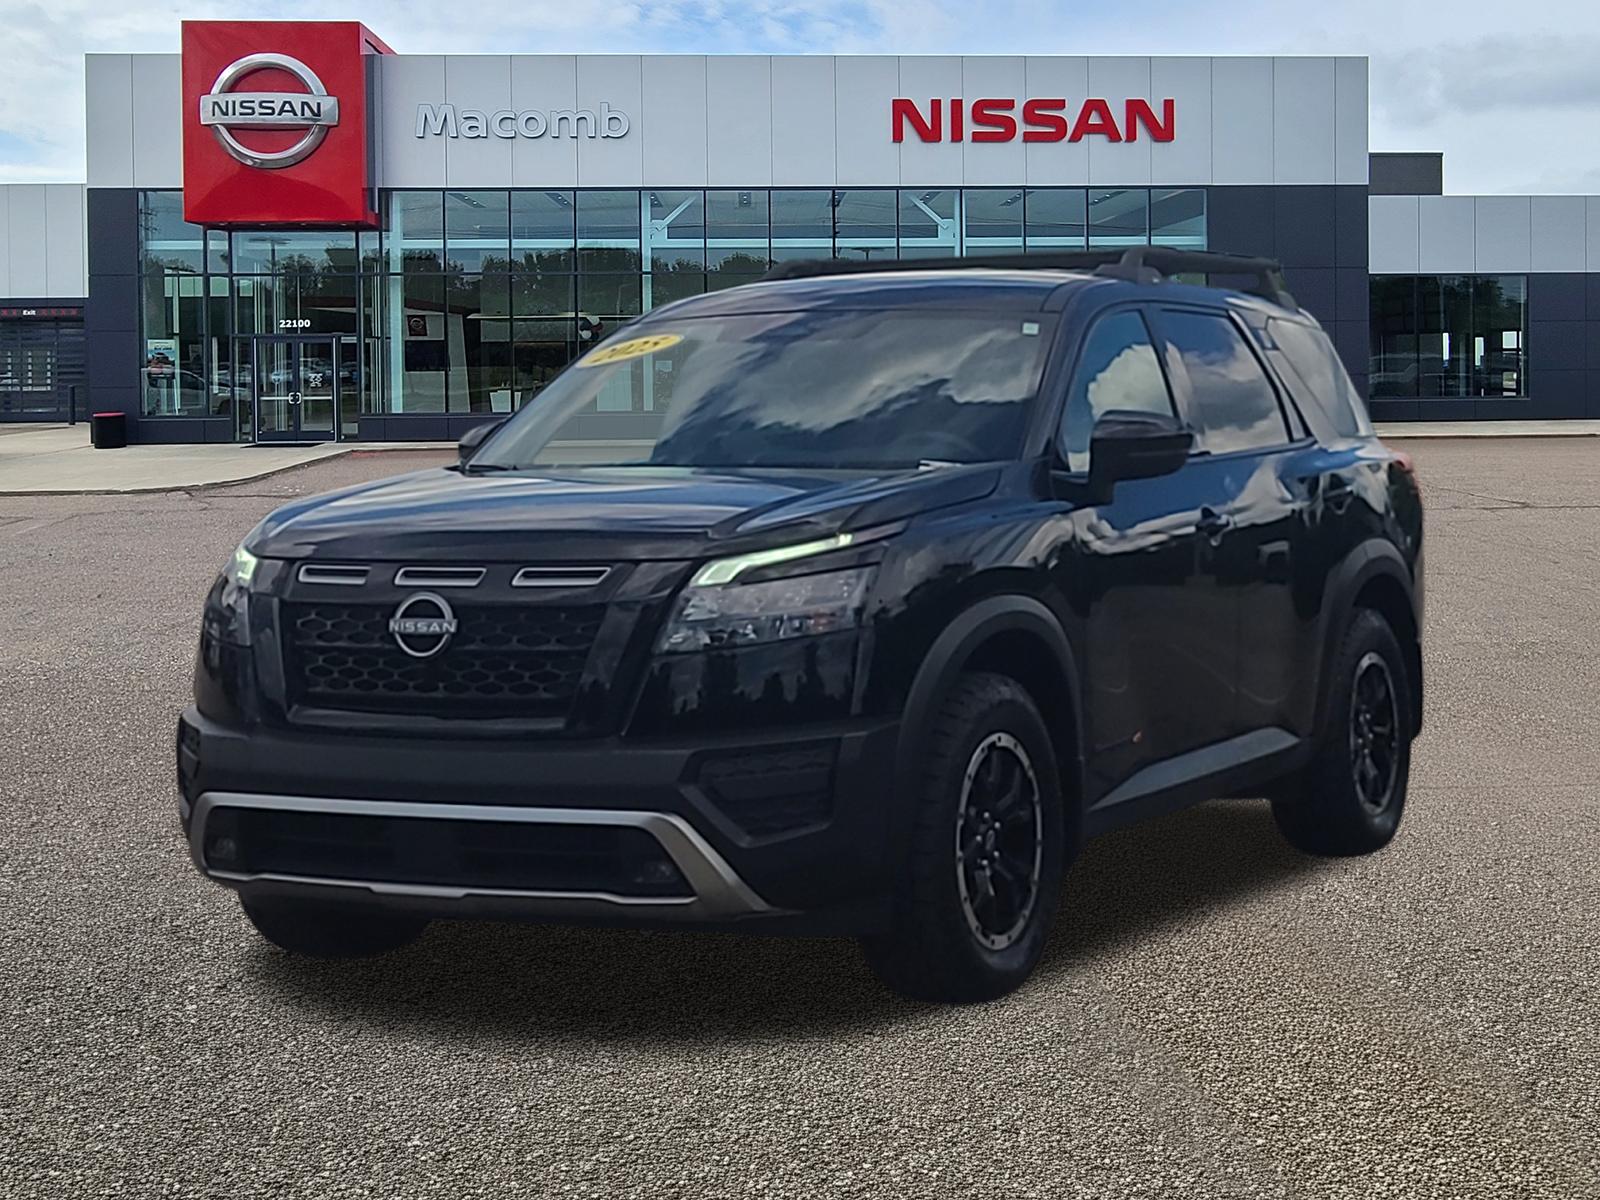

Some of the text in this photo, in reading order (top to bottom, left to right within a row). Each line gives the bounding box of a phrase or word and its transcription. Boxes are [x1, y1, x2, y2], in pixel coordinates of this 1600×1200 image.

[211, 100, 322, 118] NISSAN
[415, 102, 630, 139] Macomb
[892, 98, 1175, 143] NISSAN
[22, 308, 37, 316] Exit
[279, 319, 311, 329] 22100
[389, 619, 458, 633] NISSAN
